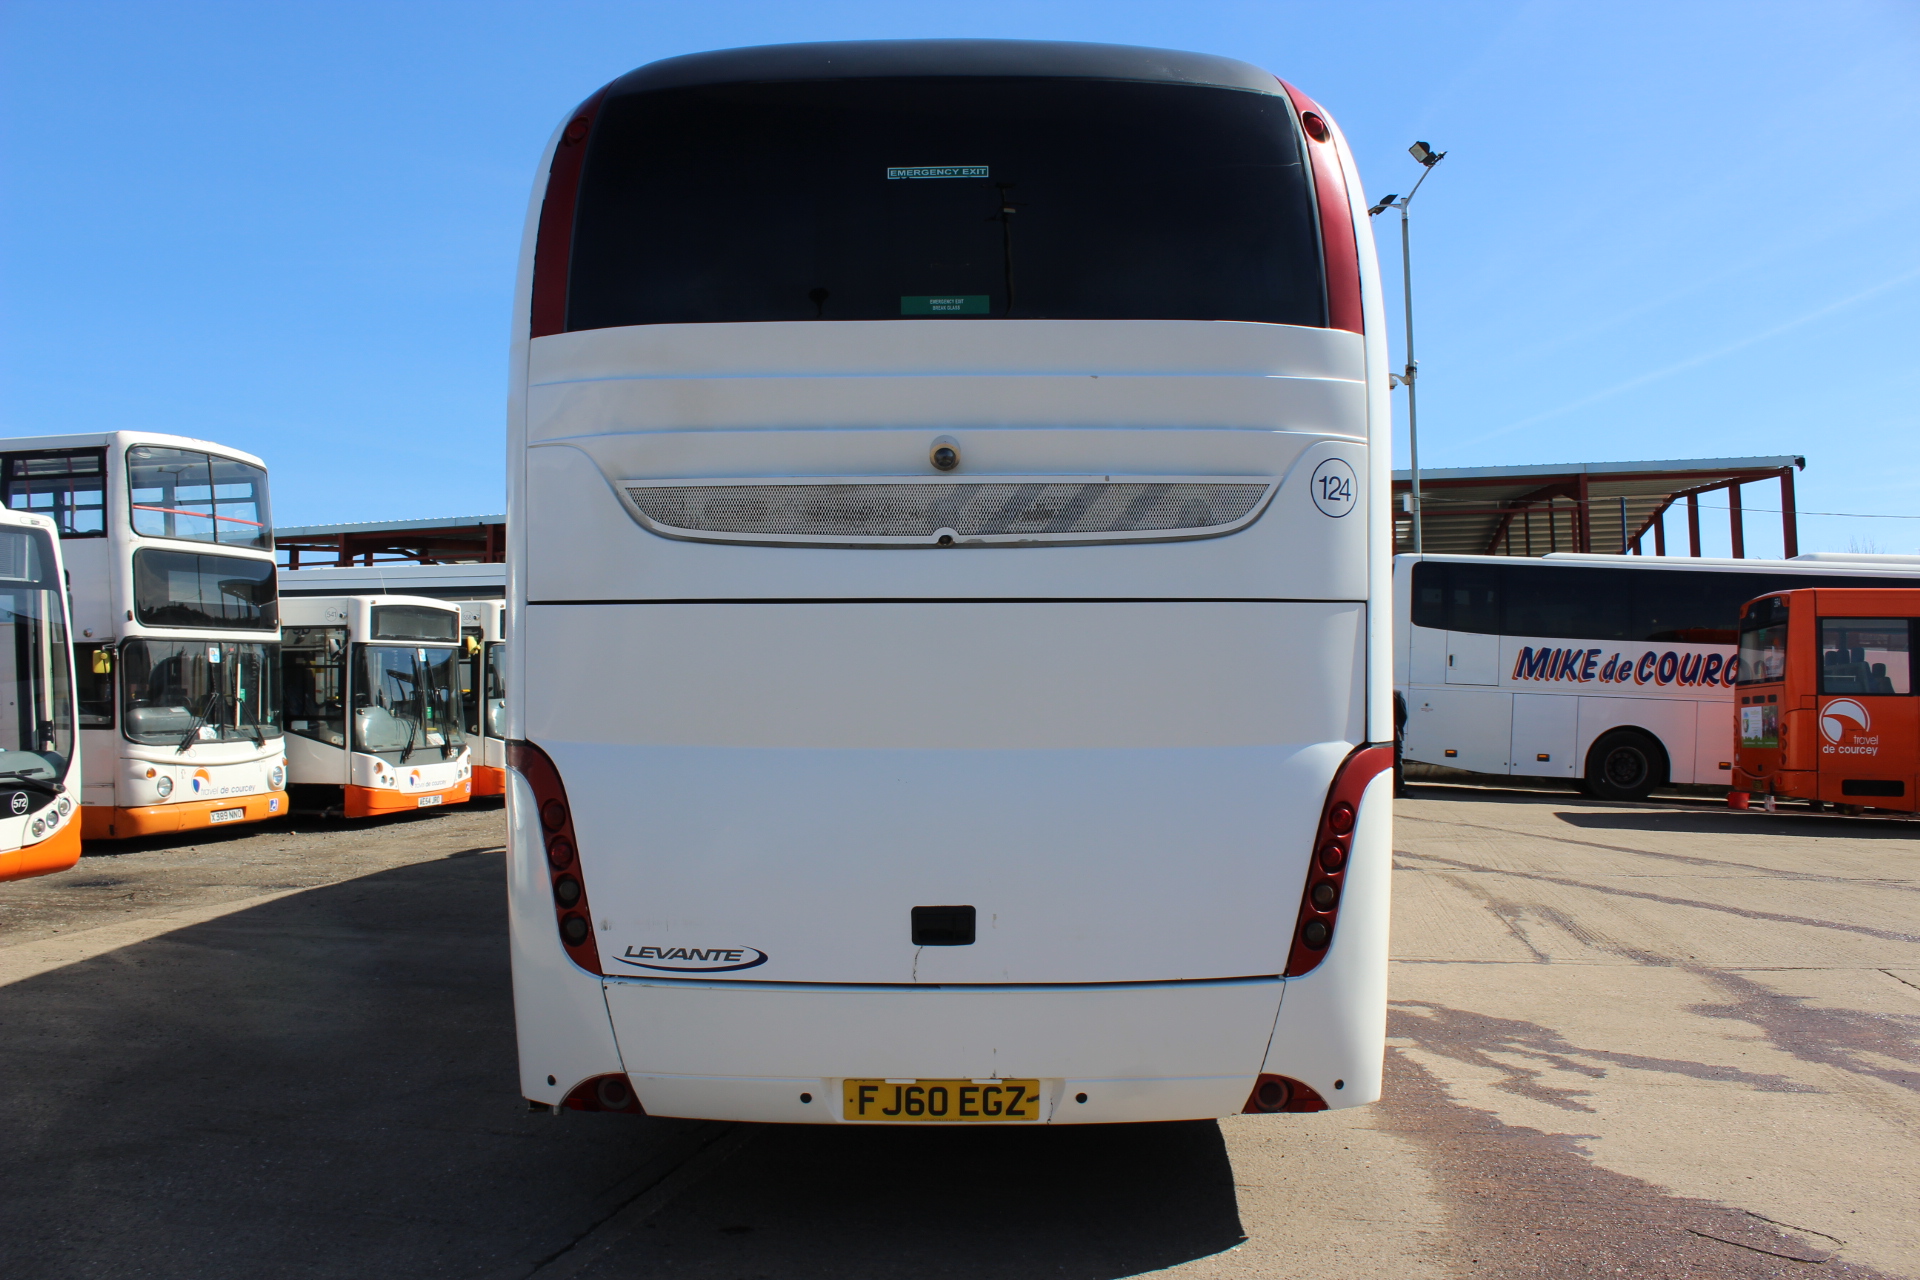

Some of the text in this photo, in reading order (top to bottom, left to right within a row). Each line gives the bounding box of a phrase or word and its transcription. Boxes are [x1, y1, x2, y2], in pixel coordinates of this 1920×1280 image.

[890, 169, 960, 177] EMERGENCY
[1318, 475, 1352, 502] 124
[1511, 646, 1602, 683] MIKE
[1599, 652, 1633, 683] de
[1853, 735, 1879, 745] travel
[1822, 744, 1878, 757] de courcey
[200, 784, 256, 796] travel de courcey
[13, 798, 27, 808] 572
[211, 811, 229, 822] X389
[624, 945, 745, 962] LEVANTE
[858, 1086, 1026, 1116] FJ60 EGZ
